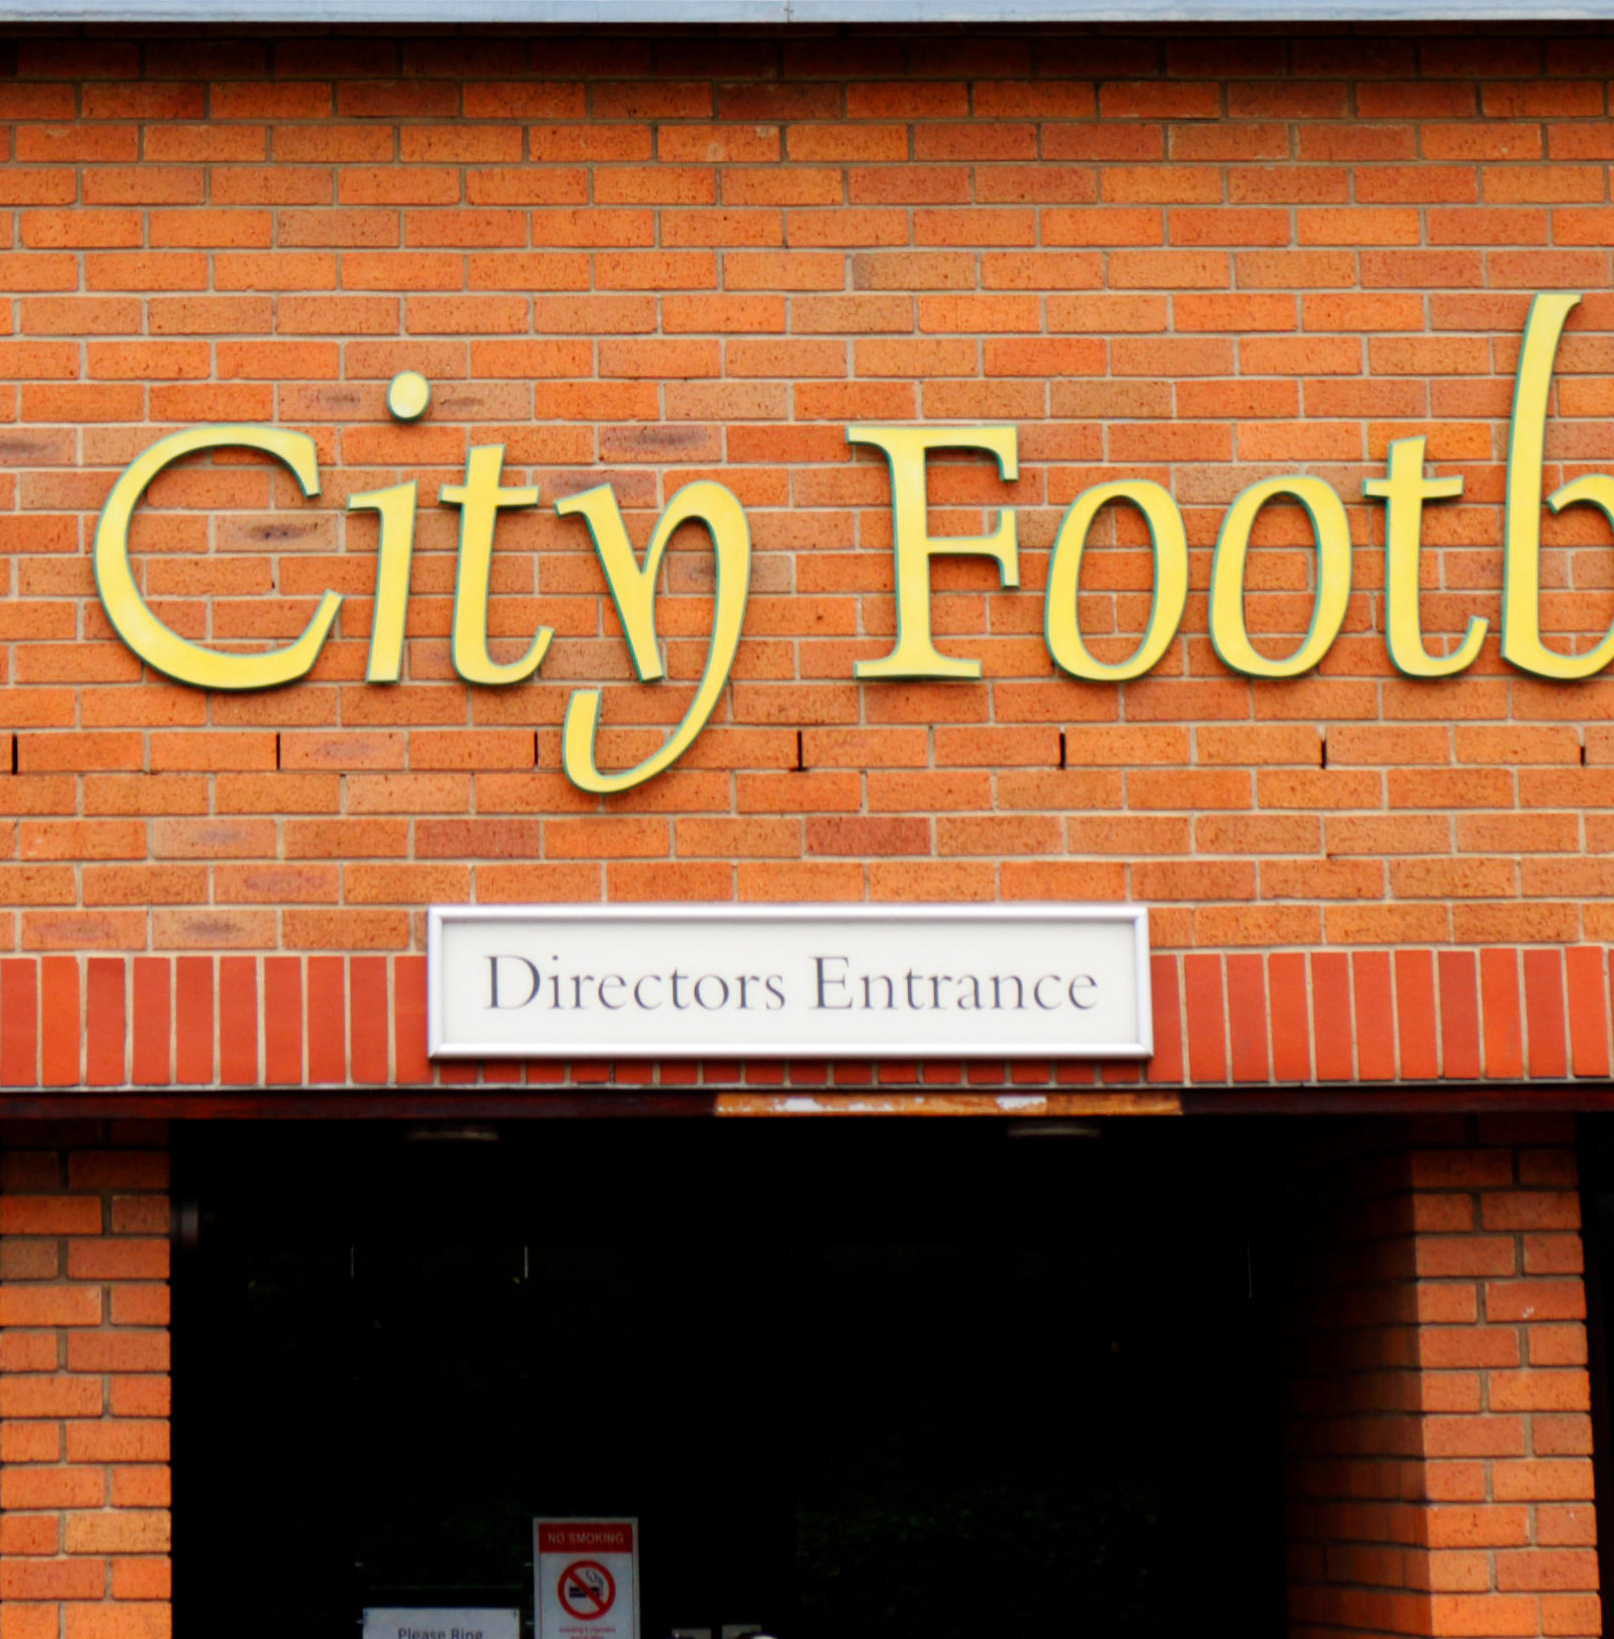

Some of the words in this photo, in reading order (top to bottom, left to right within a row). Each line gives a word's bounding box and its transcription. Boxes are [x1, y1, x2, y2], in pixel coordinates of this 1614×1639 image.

[93, 369, 753, 795] City
[481, 954, 786, 1012] Directors
[807, 954, 1099, 1012] Entrance
[546, 1531, 566, 1545] NO
[567, 1531, 625, 1545] SMOKING
[397, 1627, 446, 1639] Please
